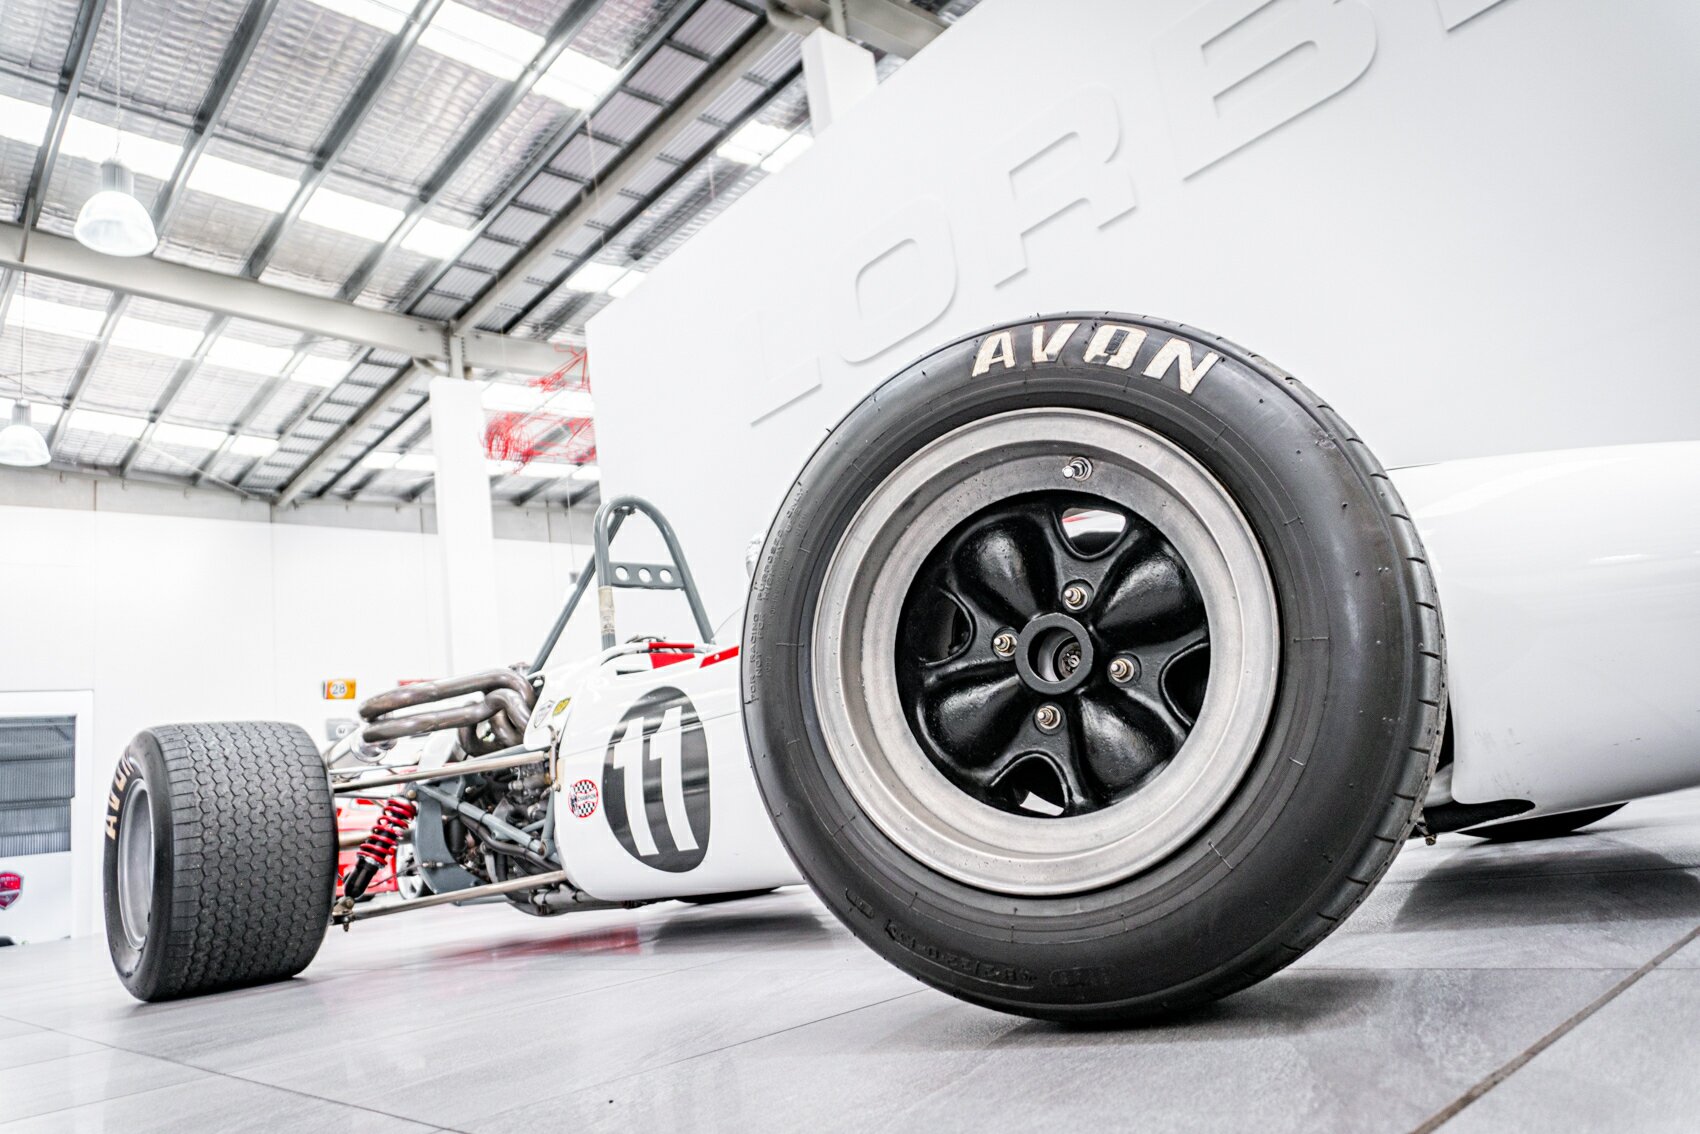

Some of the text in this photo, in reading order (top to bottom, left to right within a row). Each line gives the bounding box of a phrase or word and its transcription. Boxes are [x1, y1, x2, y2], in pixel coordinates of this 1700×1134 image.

[970, 322, 1221, 395] AVON
[750, 613, 759, 664] RACING
[332, 683, 346, 695] 28
[104, 751, 136, 841] AVON
[613, 705, 700, 857] 11
